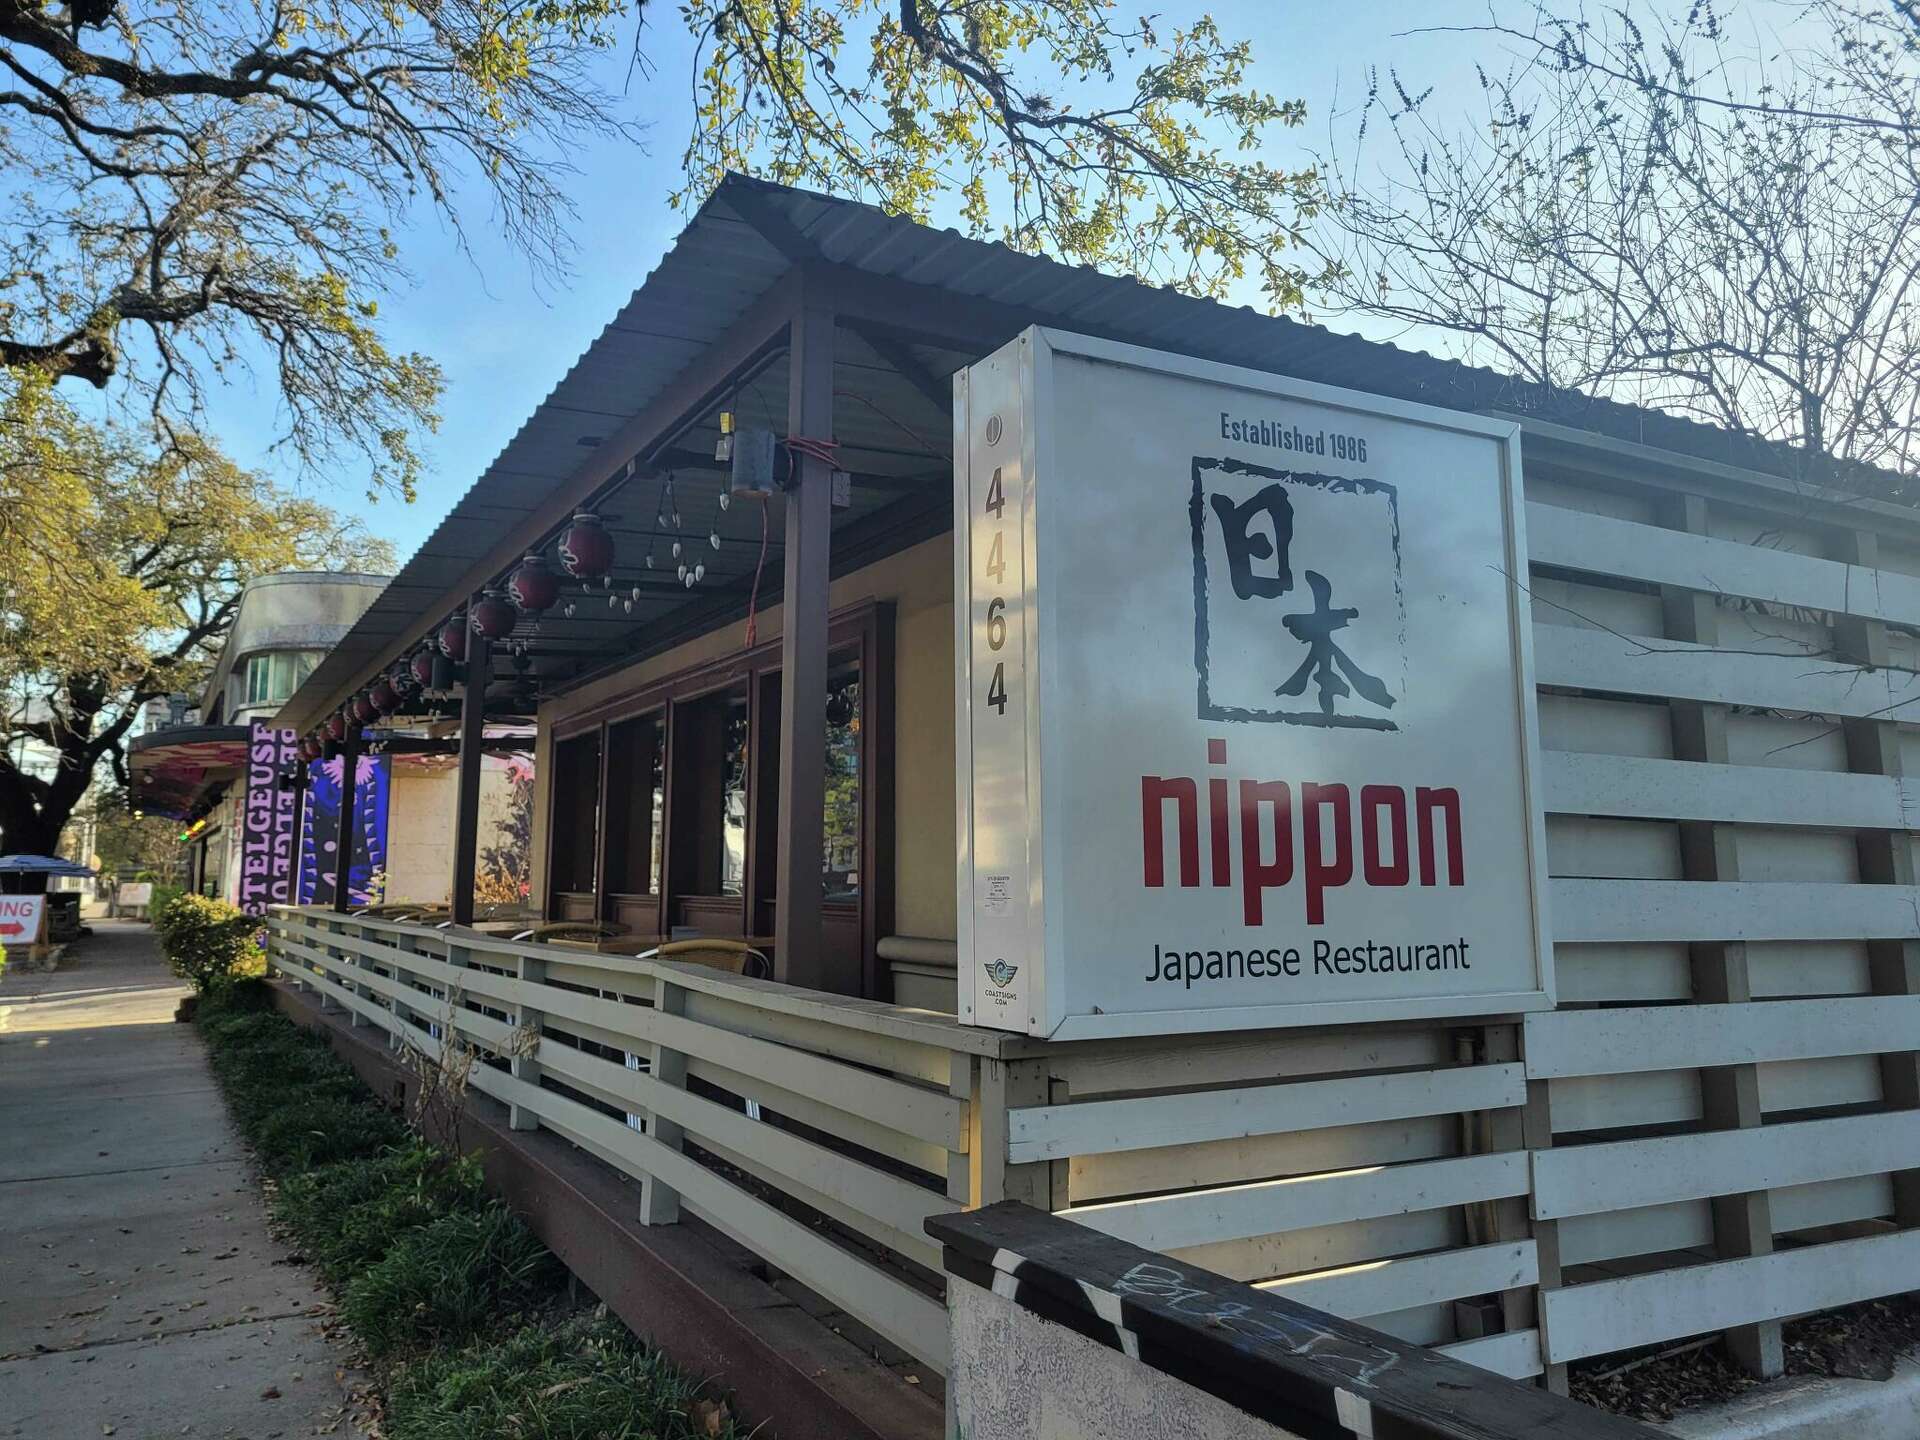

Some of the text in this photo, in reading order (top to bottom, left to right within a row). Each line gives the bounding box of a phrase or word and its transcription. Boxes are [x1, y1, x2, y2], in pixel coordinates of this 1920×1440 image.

[1220, 412, 1368, 463] Established 1986
[985, 466, 1008, 716] 4464
[1210, 483, 1397, 717] 日本
[242, 722, 276, 917] ETELGEUSE
[1142, 738, 1465, 926] nippon
[984, 989, 1017, 1001] COASTSIGNS
[1145, 937, 1471, 989] Japanese Restaurant
